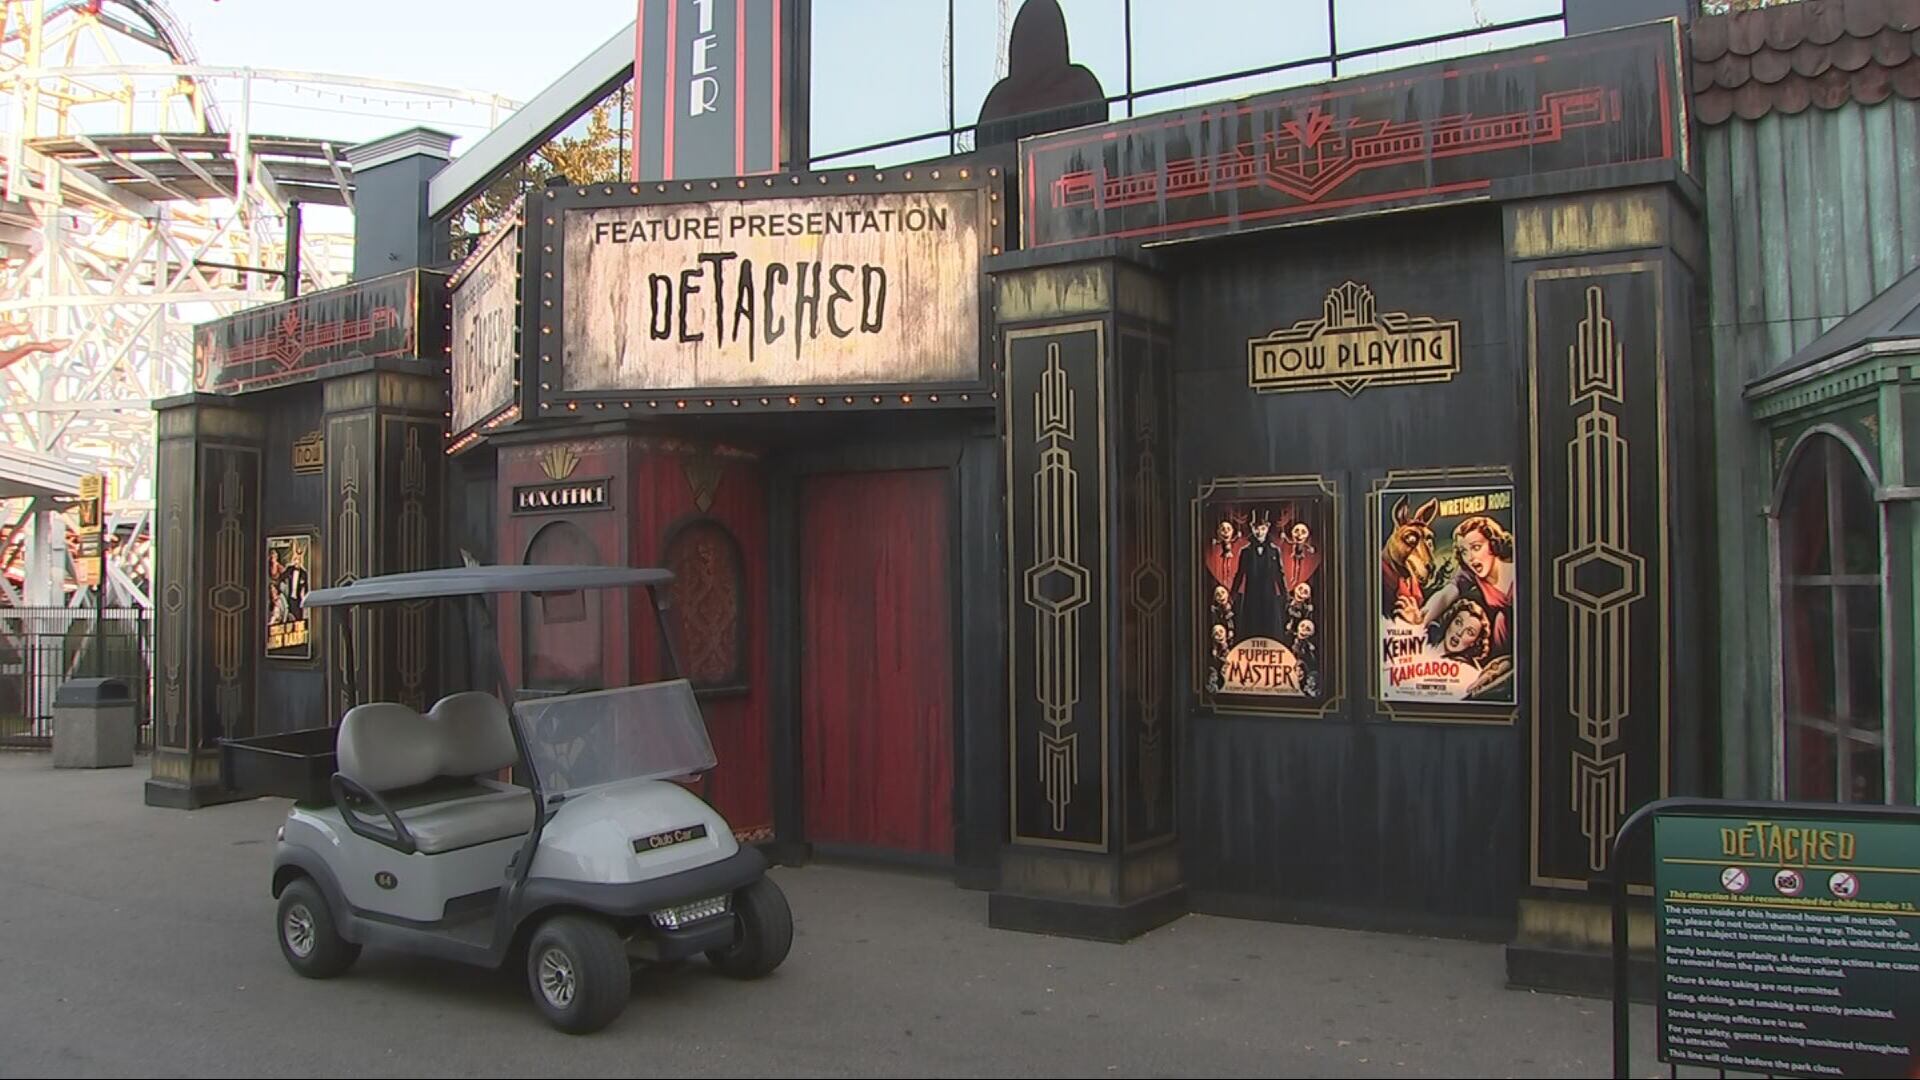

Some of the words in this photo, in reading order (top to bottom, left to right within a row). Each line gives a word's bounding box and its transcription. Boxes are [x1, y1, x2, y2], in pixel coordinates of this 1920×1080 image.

[596, 217, 719, 245] FEATURE
[730, 208, 947, 238] PRESENTATION
[648, 251, 887, 363] DETACHED
[1263, 346, 1325, 374] NOW
[1338, 335, 1442, 368] PLAYING
[520, 490, 549, 507] BOX
[551, 486, 603, 505] OFFICE
[1251, 640, 1267, 648] THE
[1383, 636, 1426, 664] KENNY
[1238, 649, 1285, 664] PUPPET
[1228, 661, 1295, 689] MASTER
[1390, 661, 1459, 688] KANGAROO
[649, 834, 673, 848] Club
[674, 830, 692, 842] Car
[1721, 821, 1857, 867] DETACHED
[1665, 905, 1680, 914] The
[1710, 908, 1735, 916] inside
[1737, 909, 1746, 917] of
[1747, 910, 1764, 918] this
[1765, 911, 1802, 920] haunted
[1804, 913, 1832, 922] house
[1833, 914, 1849, 922] will
[1851, 916, 1868, 924] not
[1869, 917, 1896, 926] touch
[1694, 929, 1704, 937] be
[1706, 931, 1737, 940] subject
[1750, 933, 1785, 942] removal
[1787, 935, 1809, 944] from
[1810, 937, 1825, 945] the
[1826, 938, 1848, 947] park
[1848, 939, 1885, 949] without
[1666, 956, 1678, 964] for
[1680, 959, 1715, 967] removal
[1716, 960, 1736, 969] from
[1738, 962, 1752, 970] the
[1754, 963, 1776, 973] park
[1776, 965, 1810, 975] without
[1812, 967, 1847, 978] refund.
[1666, 974, 1696, 984] Picture
[1698, 976, 1705, 985] &
[1706, 978, 1730, 987] video
[1732, 980, 1759, 991] taking
[1761, 983, 1775, 991] are
[1776, 984, 1792, 992] not
[1793, 986, 1842, 996] permitted.
[1667, 991, 1696, 1003] Eating,
[1698, 994, 1736, 1006] drinking,
[1738, 998, 1754, 1007] and
[1756, 1000, 1794, 1012] smoking
[1796, 1004, 1810, 1012] are
[1812, 1005, 1842, 1015] strictly
[1844, 1007, 1896, 1019] prohibited.
[1668, 1009, 1695, 1019] Strobe
[1697, 1012, 1731, 1023] lighting
[1732, 1015, 1760, 1025] effects
[1778, 1019, 1787, 1027] in
[1788, 1021, 1807, 1029] use.
[1668, 1024, 1681, 1032] For
[1683, 1027, 1703, 1035] your
[1704, 1028, 1732, 1039] safety,
[1733, 1032, 1762, 1041] guests
[1779, 1035, 1805, 1047] being
[1806, 1039, 1854, 1050] monitored
[1855, 1042, 1910, 1055] throughout
[1668, 1036, 1684, 1044] this
[1686, 1038, 1730, 1049] attraction.
[1668, 1048, 1686, 1058] This
[1687, 1051, 1703, 1060] line
[1705, 1053, 1720, 1061] will
[1721, 1055, 1743, 1064] close
[1744, 1056, 1773, 1067] before
[1774, 1060, 1790, 1069] the
[1791, 1062, 1812, 1072] park
[1812, 1064, 1844, 1075] closes.
